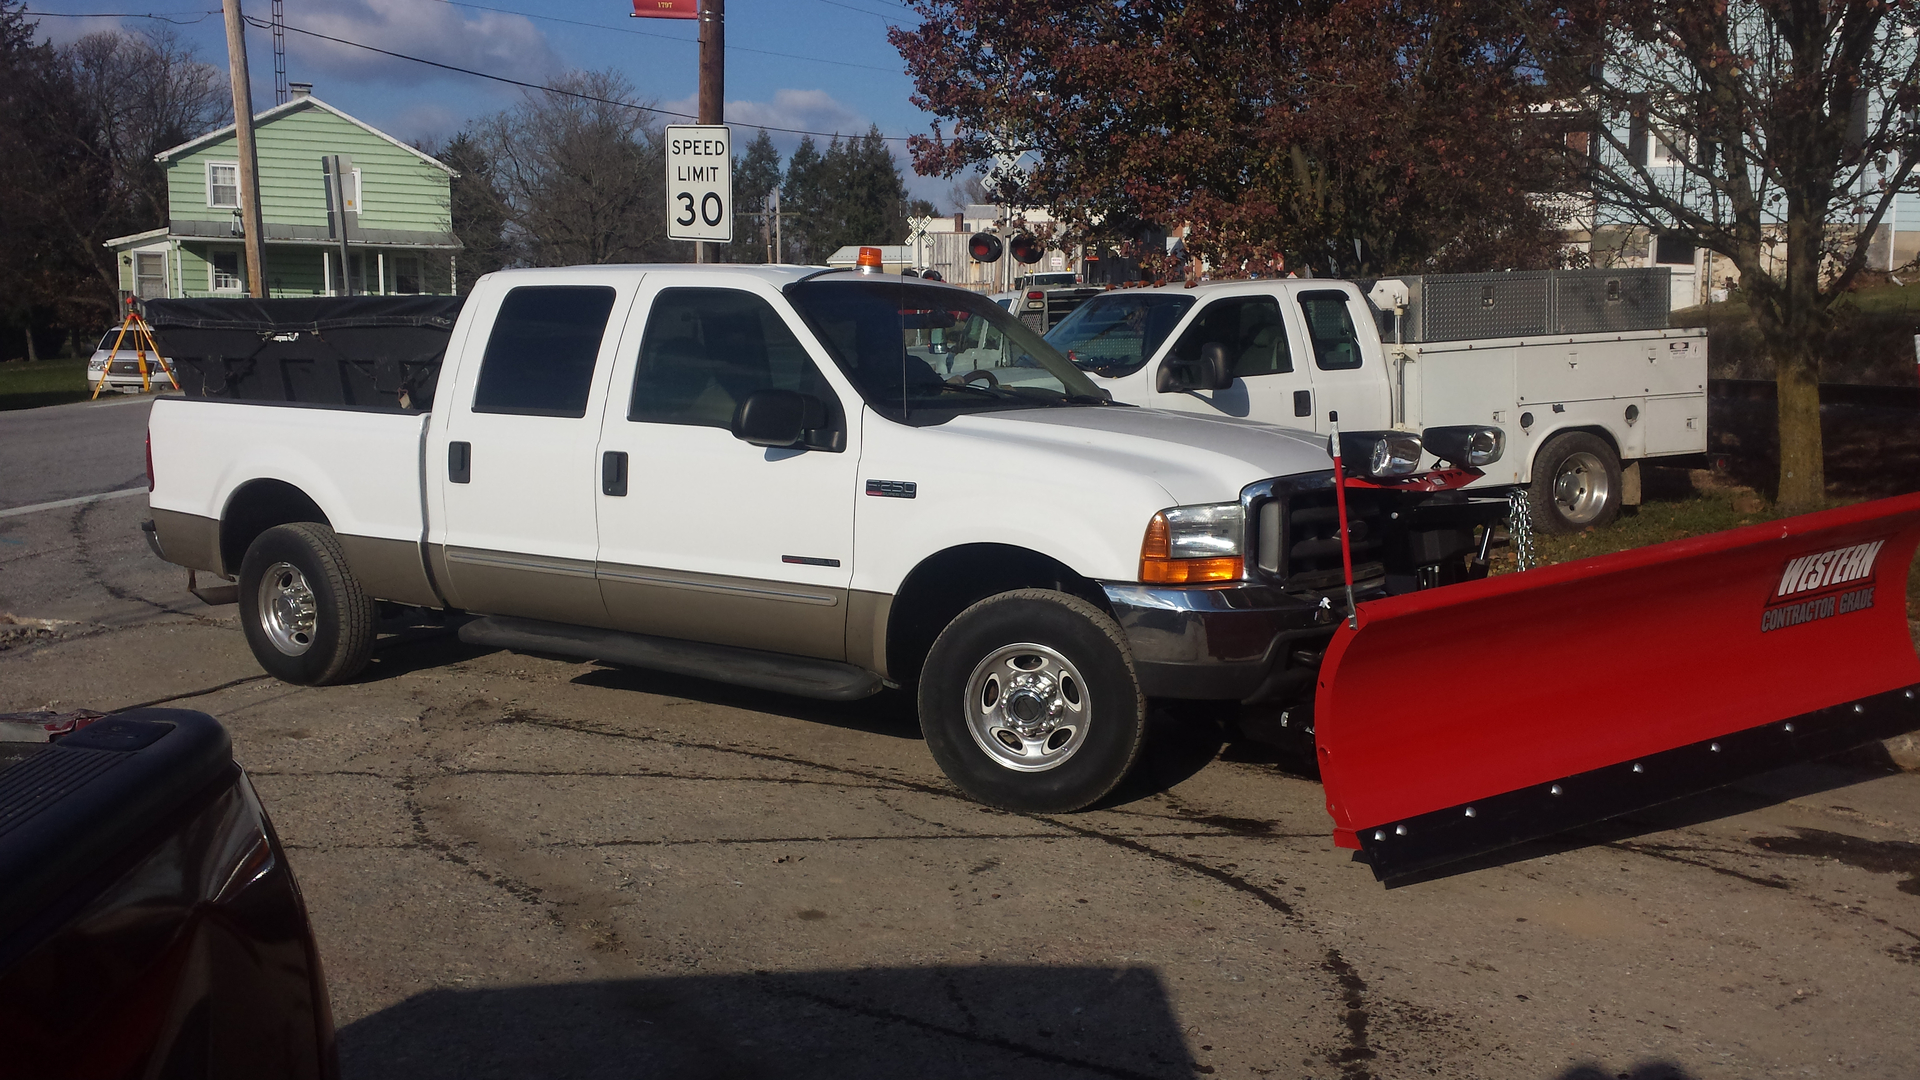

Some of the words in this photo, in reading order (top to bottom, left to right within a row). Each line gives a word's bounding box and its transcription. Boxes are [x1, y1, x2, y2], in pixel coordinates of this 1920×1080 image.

[672, 139, 725, 156] SPEED
[678, 166, 719, 182] LIMIT
[676, 192, 723, 227] 30
[867, 480, 915, 493] F-250
[1778, 540, 1885, 596] WESTERN
[1761, 596, 1836, 633] CONTRACTOR
[1839, 587, 1875, 615] GRADE
